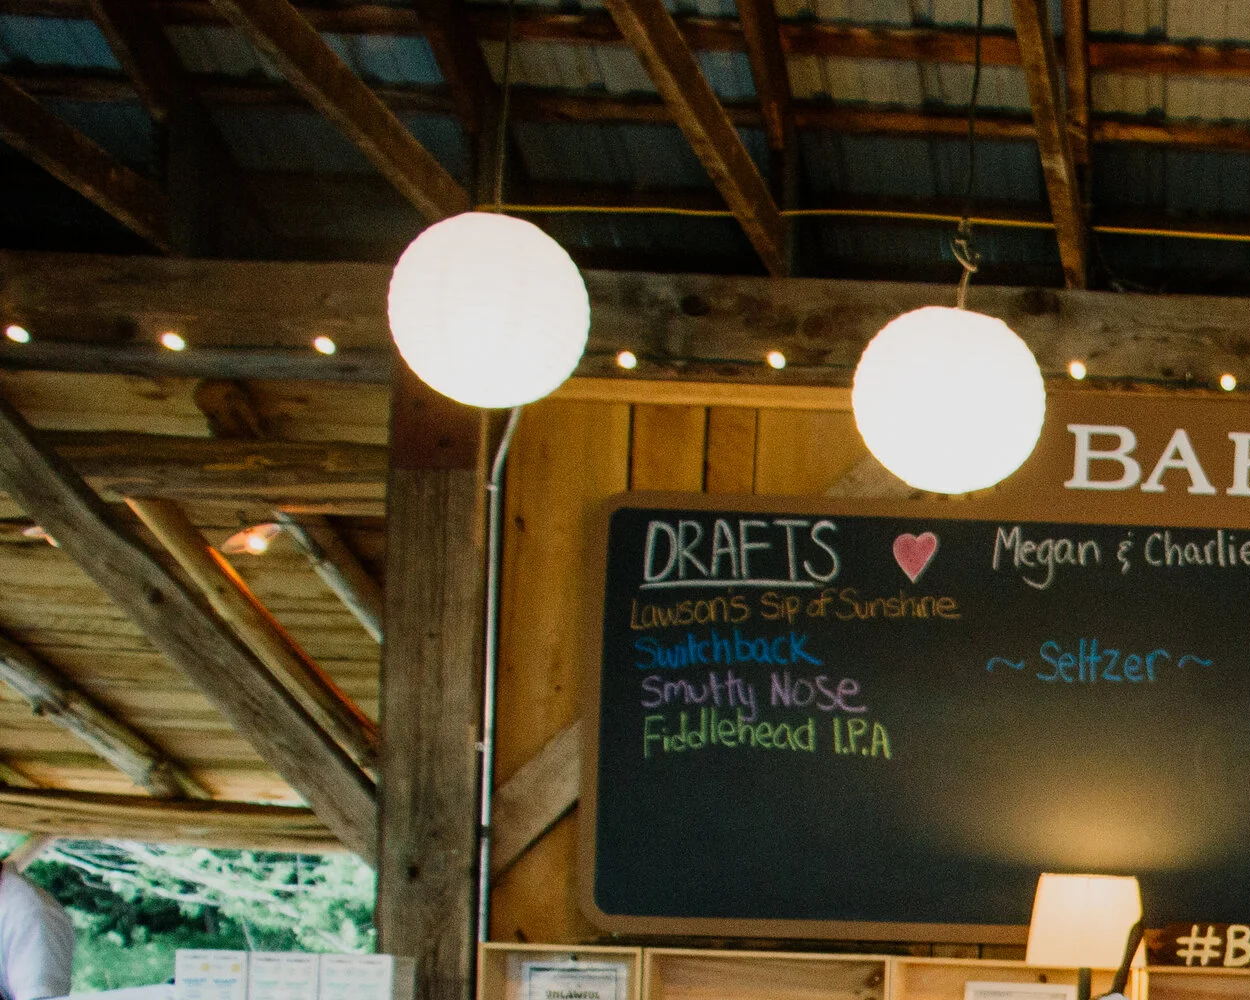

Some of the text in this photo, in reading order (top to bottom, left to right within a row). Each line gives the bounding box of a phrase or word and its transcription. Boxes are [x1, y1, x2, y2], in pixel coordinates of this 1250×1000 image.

[643, 518, 839, 583] DRAFTS
[992, 526, 1100, 590] Megan
[1117, 531, 1135, 574] &
[760, 592, 800, 621] Sip
[807, 589, 832, 618] of
[835, 588, 961, 620] Sunshine
[634, 629, 823, 669] Switchback
[1036, 638, 1170, 682] Seltzer
[641, 670, 756, 722] Smutty
[643, 706, 891, 760] Fiddlehead I.P.A
